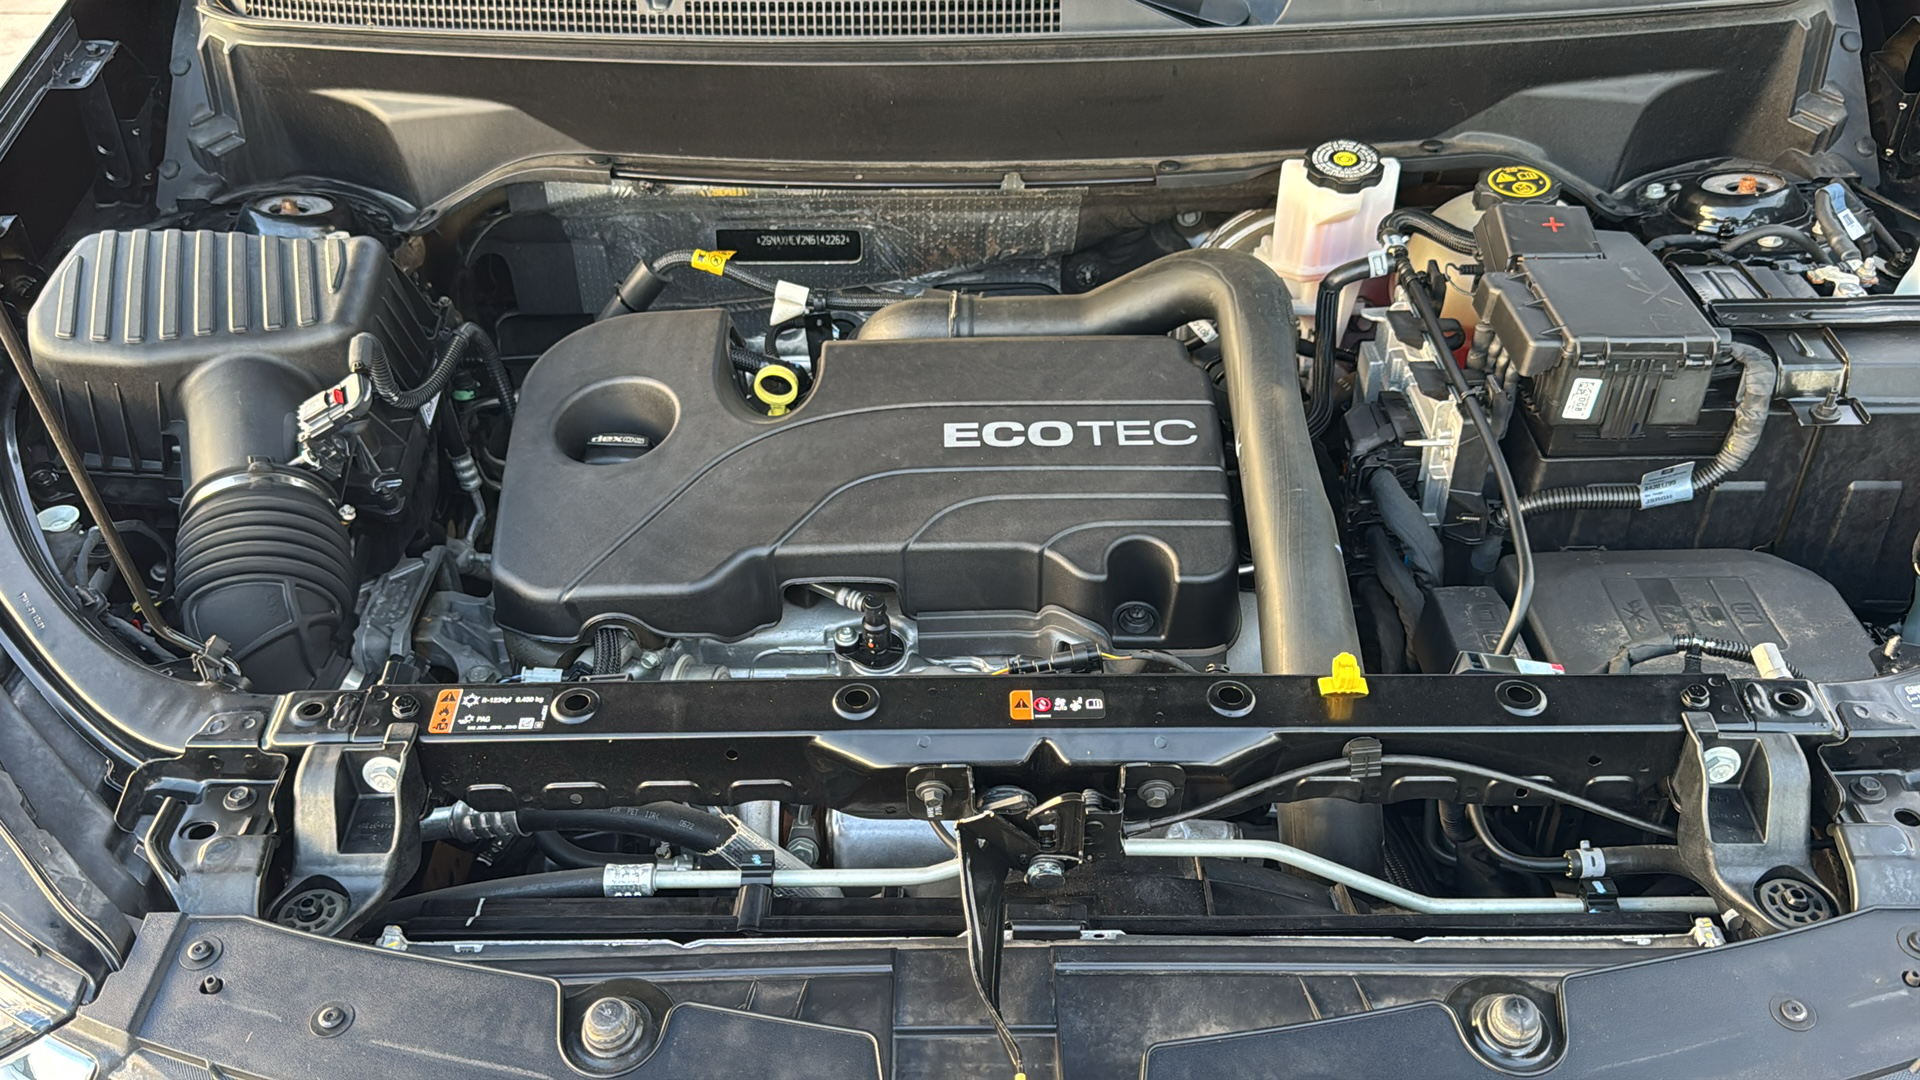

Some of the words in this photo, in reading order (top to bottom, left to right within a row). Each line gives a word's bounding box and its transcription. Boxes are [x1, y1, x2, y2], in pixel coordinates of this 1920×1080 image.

[943, 419, 1198, 448] ECOTEC
[591, 435, 645, 445] dexos
[481, 696, 513, 705] R-1234yf
[534, 696, 545, 704] kg
[476, 715, 491, 723] PAG
